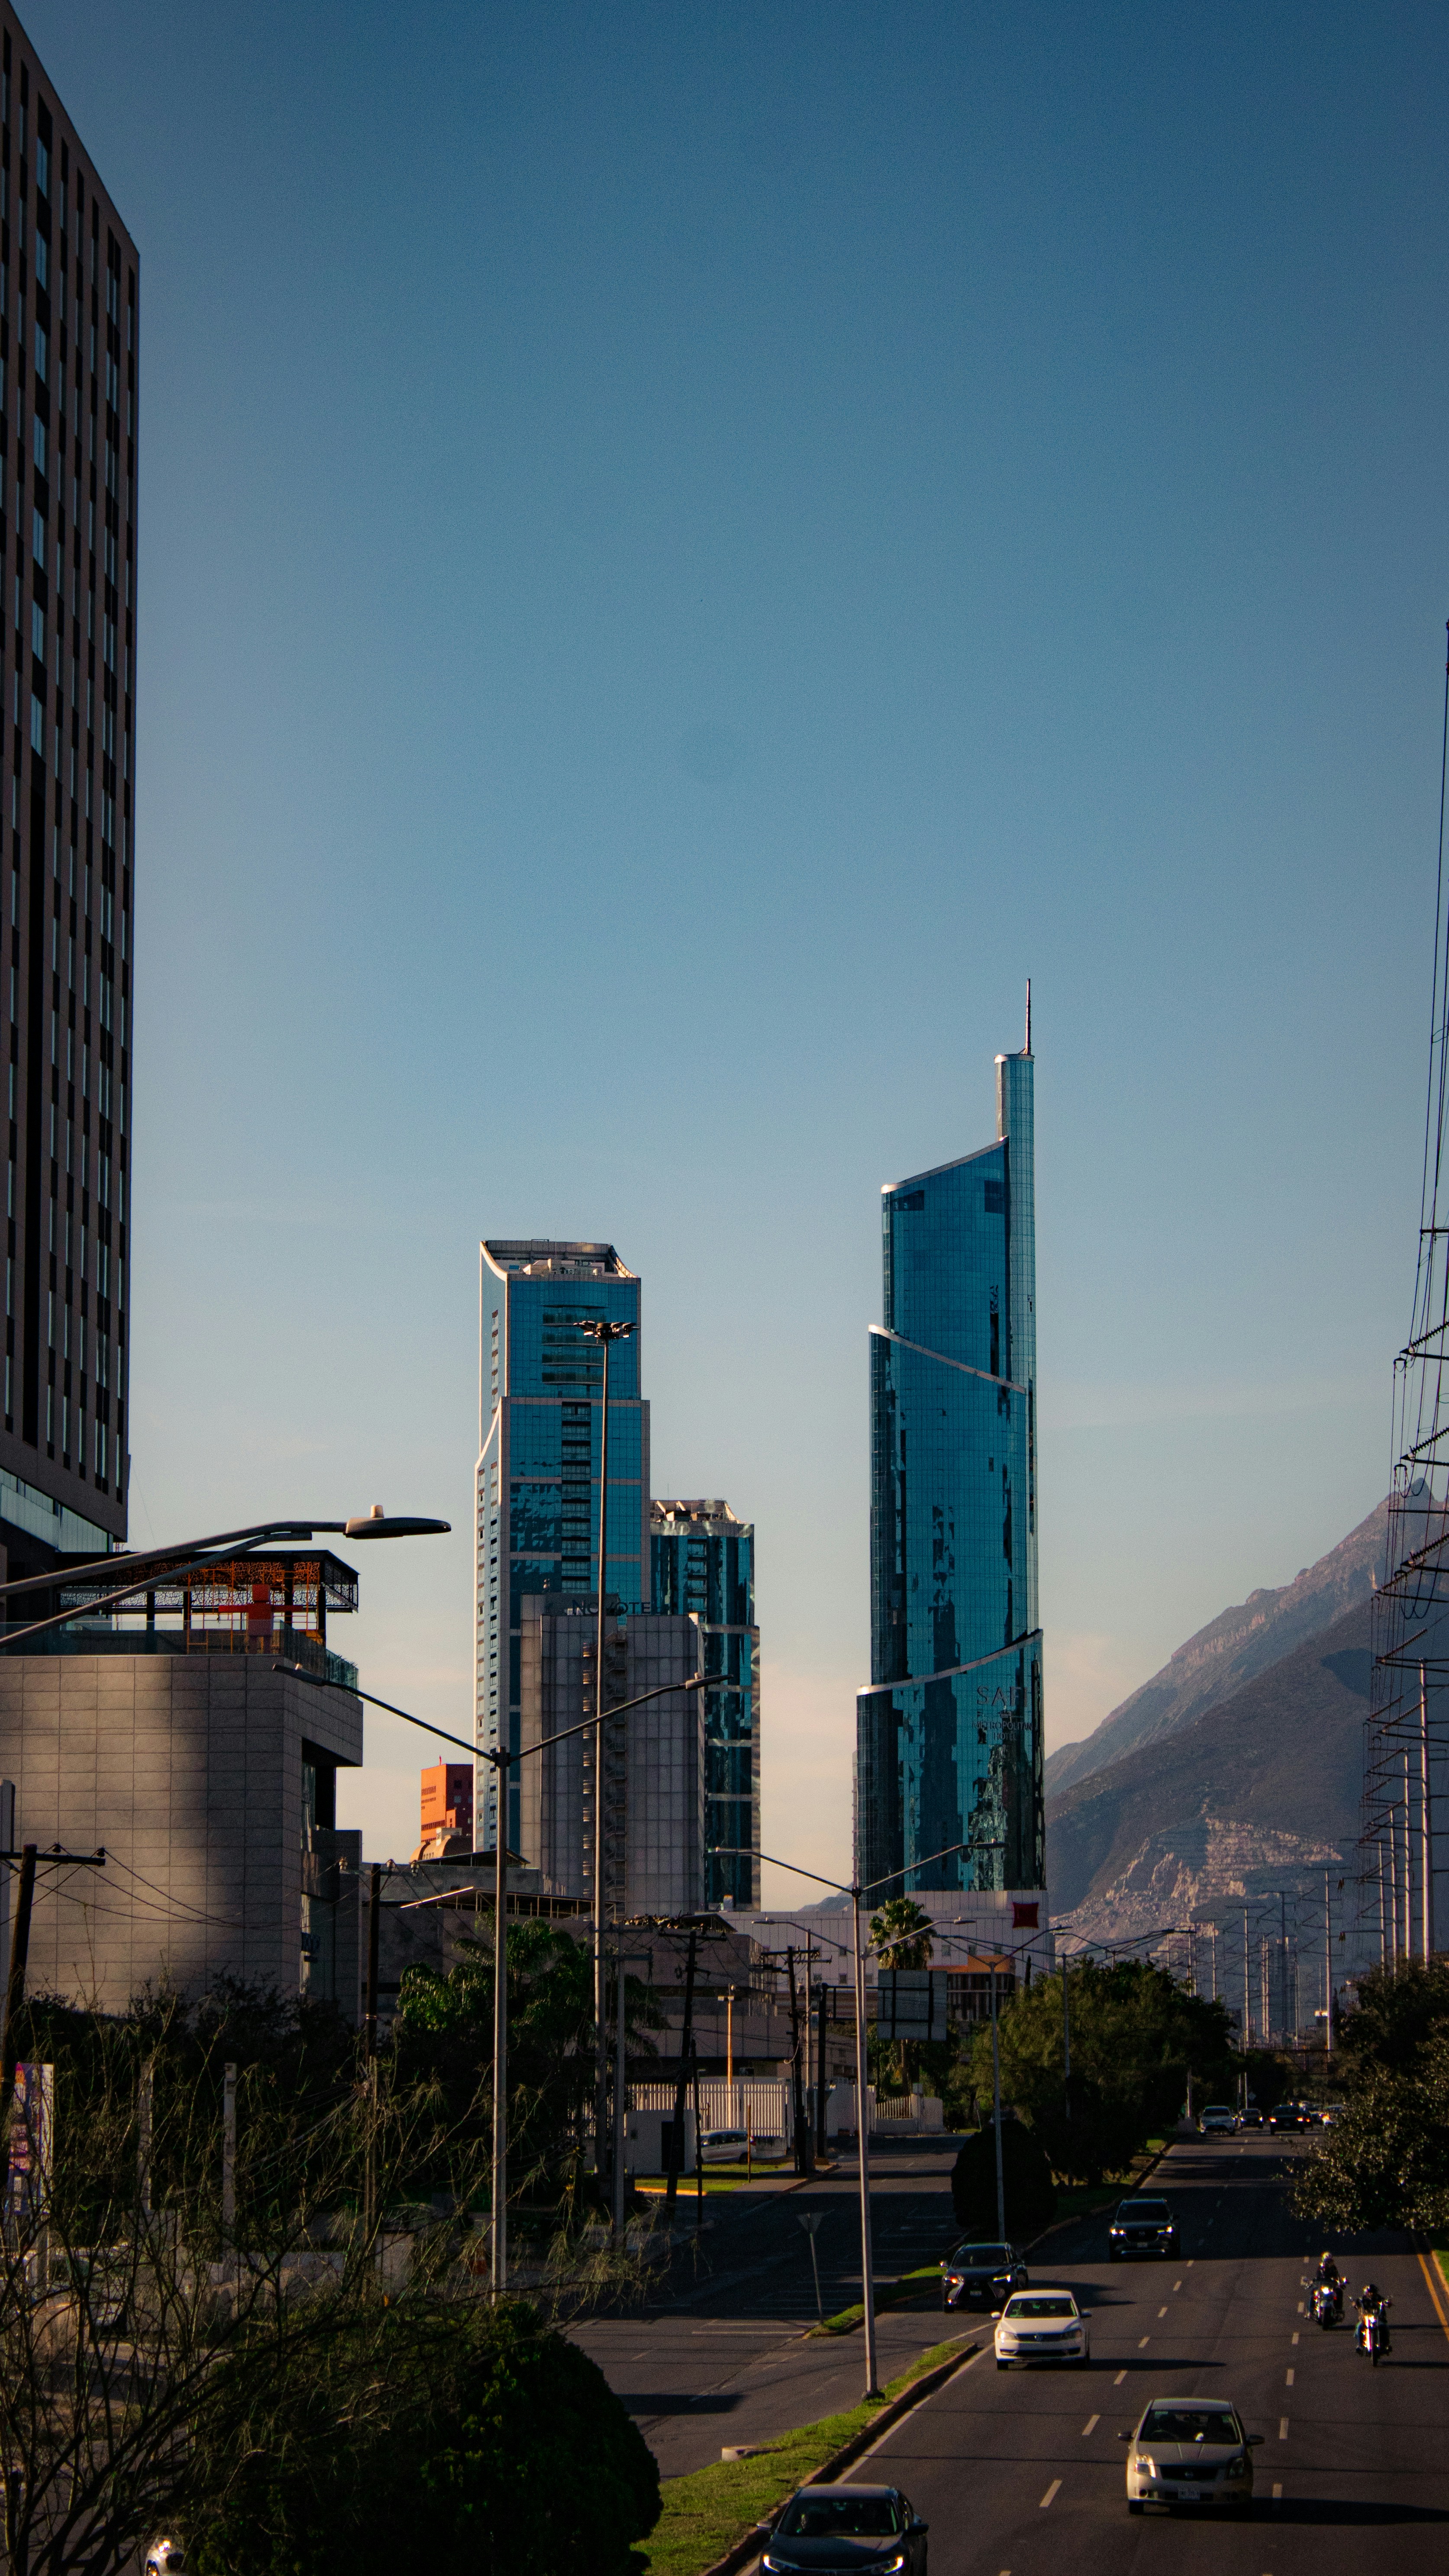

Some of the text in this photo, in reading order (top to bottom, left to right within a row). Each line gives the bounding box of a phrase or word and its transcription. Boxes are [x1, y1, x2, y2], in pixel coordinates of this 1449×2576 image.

[572, 1600, 660, 1614] NOOTE
[977, 1686, 1027, 1707] SAFI
[972, 1721, 1033, 1730] METROPOLITAN
[993, 1732, 1017, 1741] HOTEL
